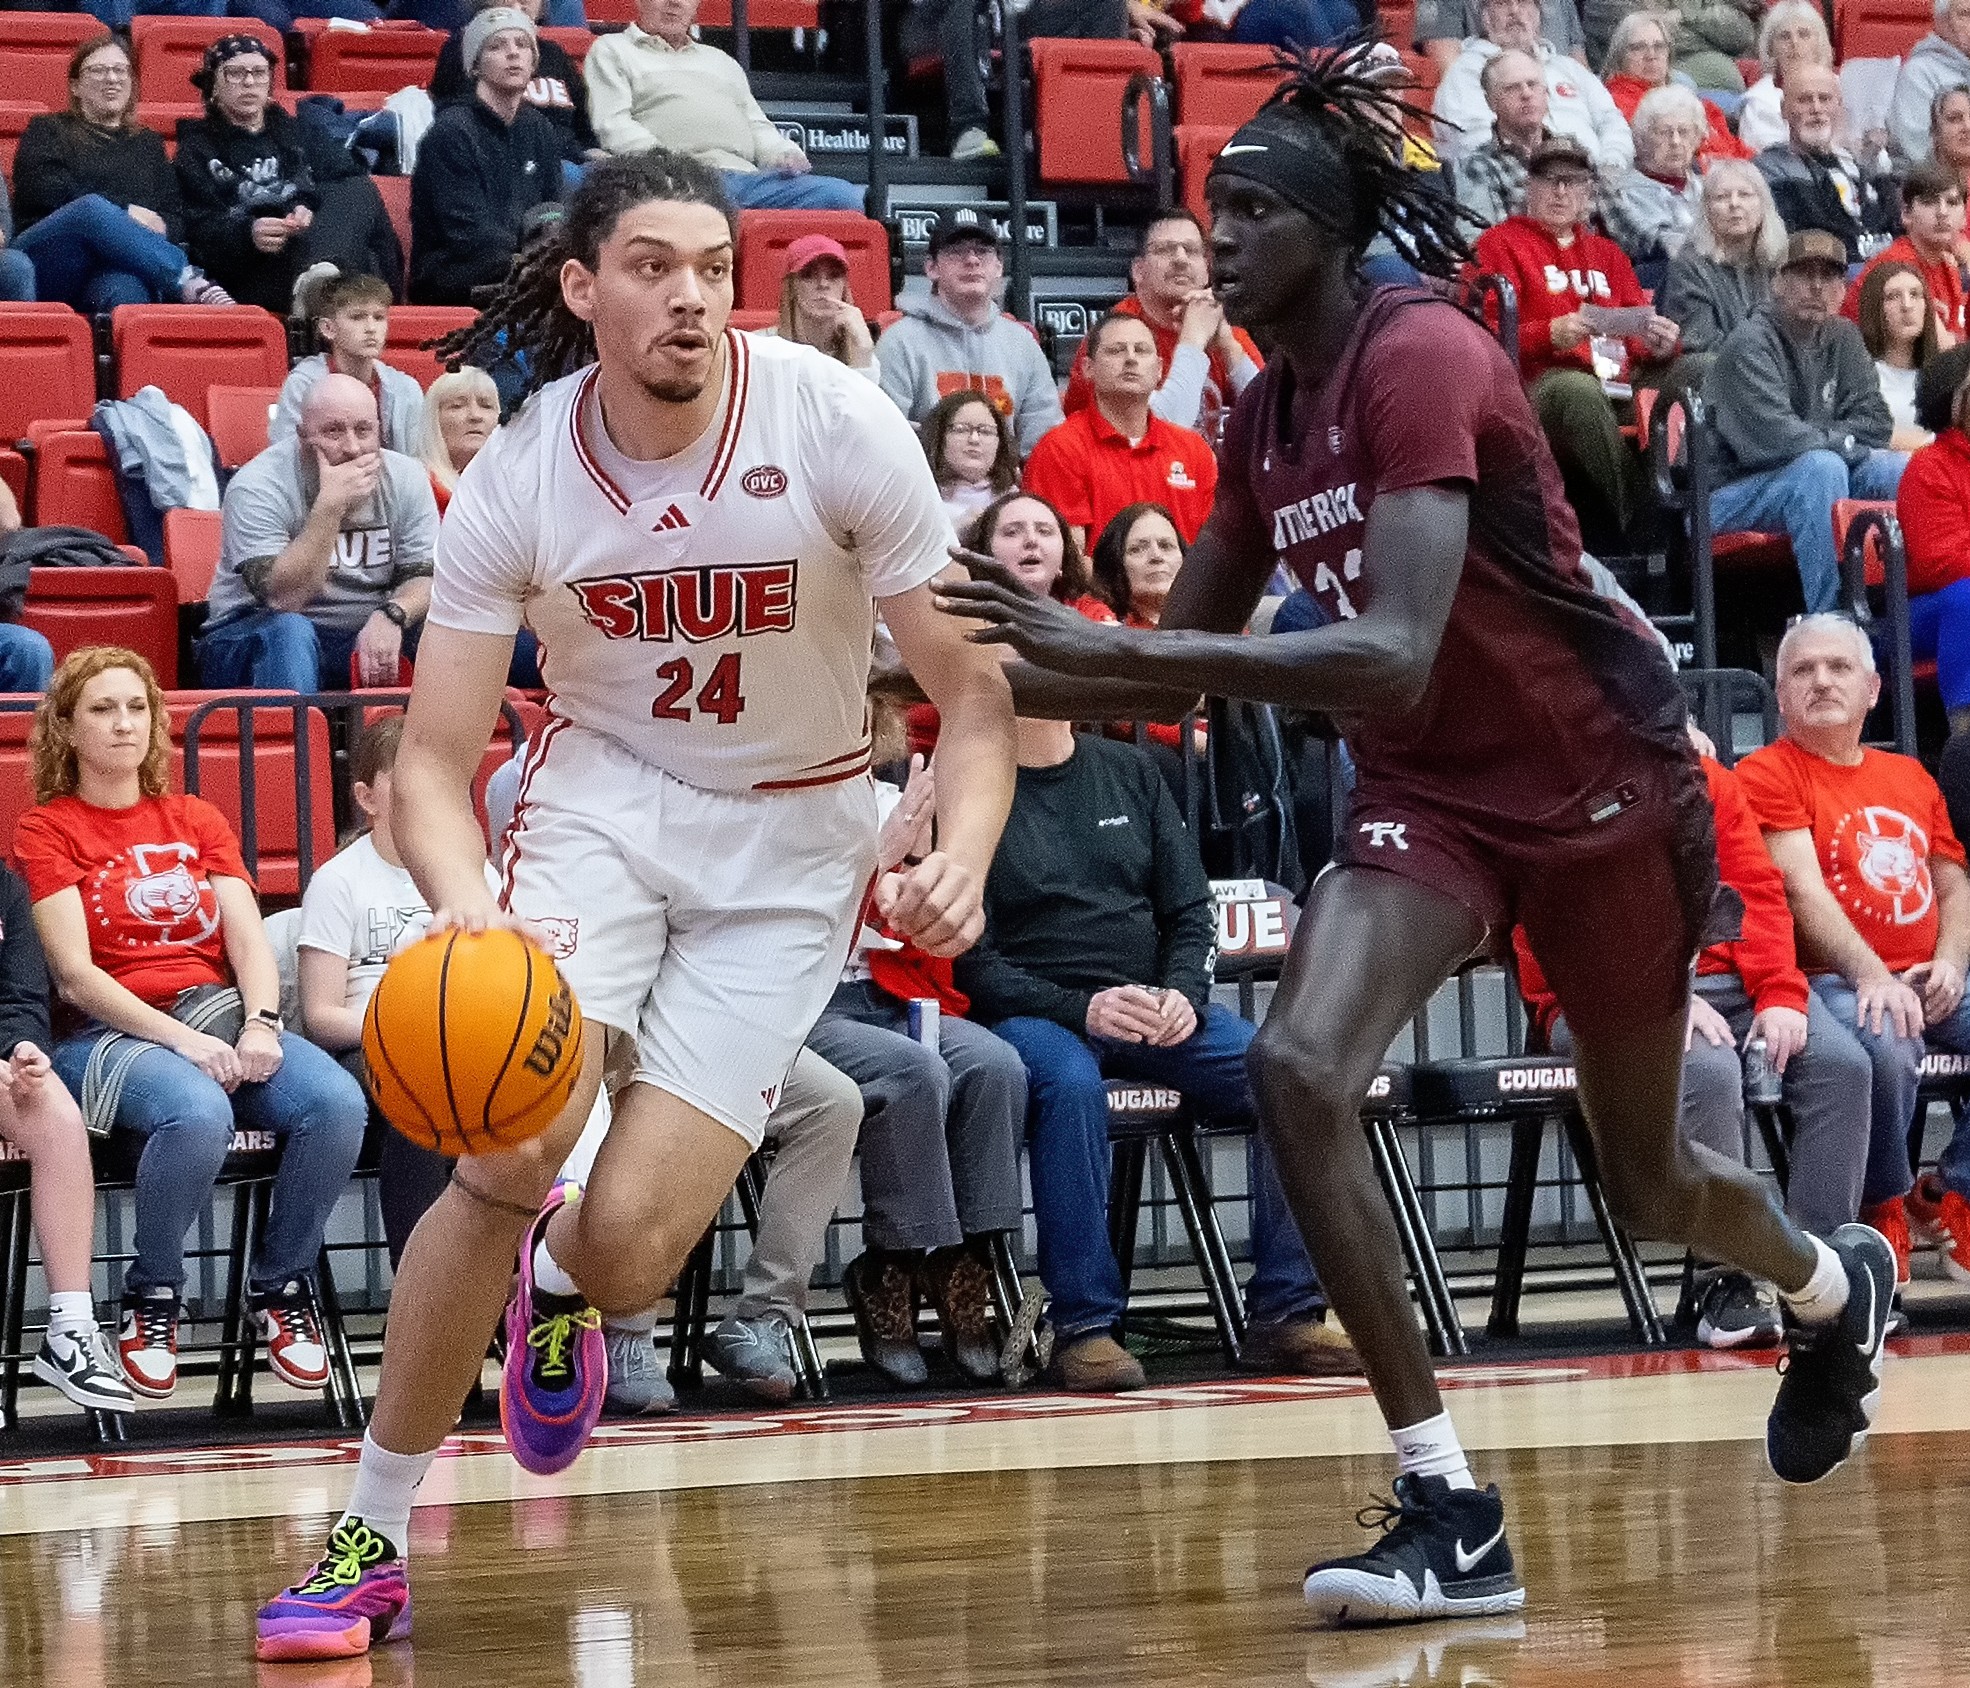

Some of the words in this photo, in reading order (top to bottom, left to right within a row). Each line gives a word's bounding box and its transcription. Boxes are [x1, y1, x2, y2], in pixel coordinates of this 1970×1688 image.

[523, 78, 574, 106] UE
[750, 474, 780, 490] OVC
[329, 528, 391, 568] UE
[565, 560, 798, 644] SIUE
[651, 652, 746, 724] 24
[1214, 885, 1238, 896] AVY
[1218, 900, 1288, 952] UE
[1499, 1067, 1578, 1091] COUGAR
